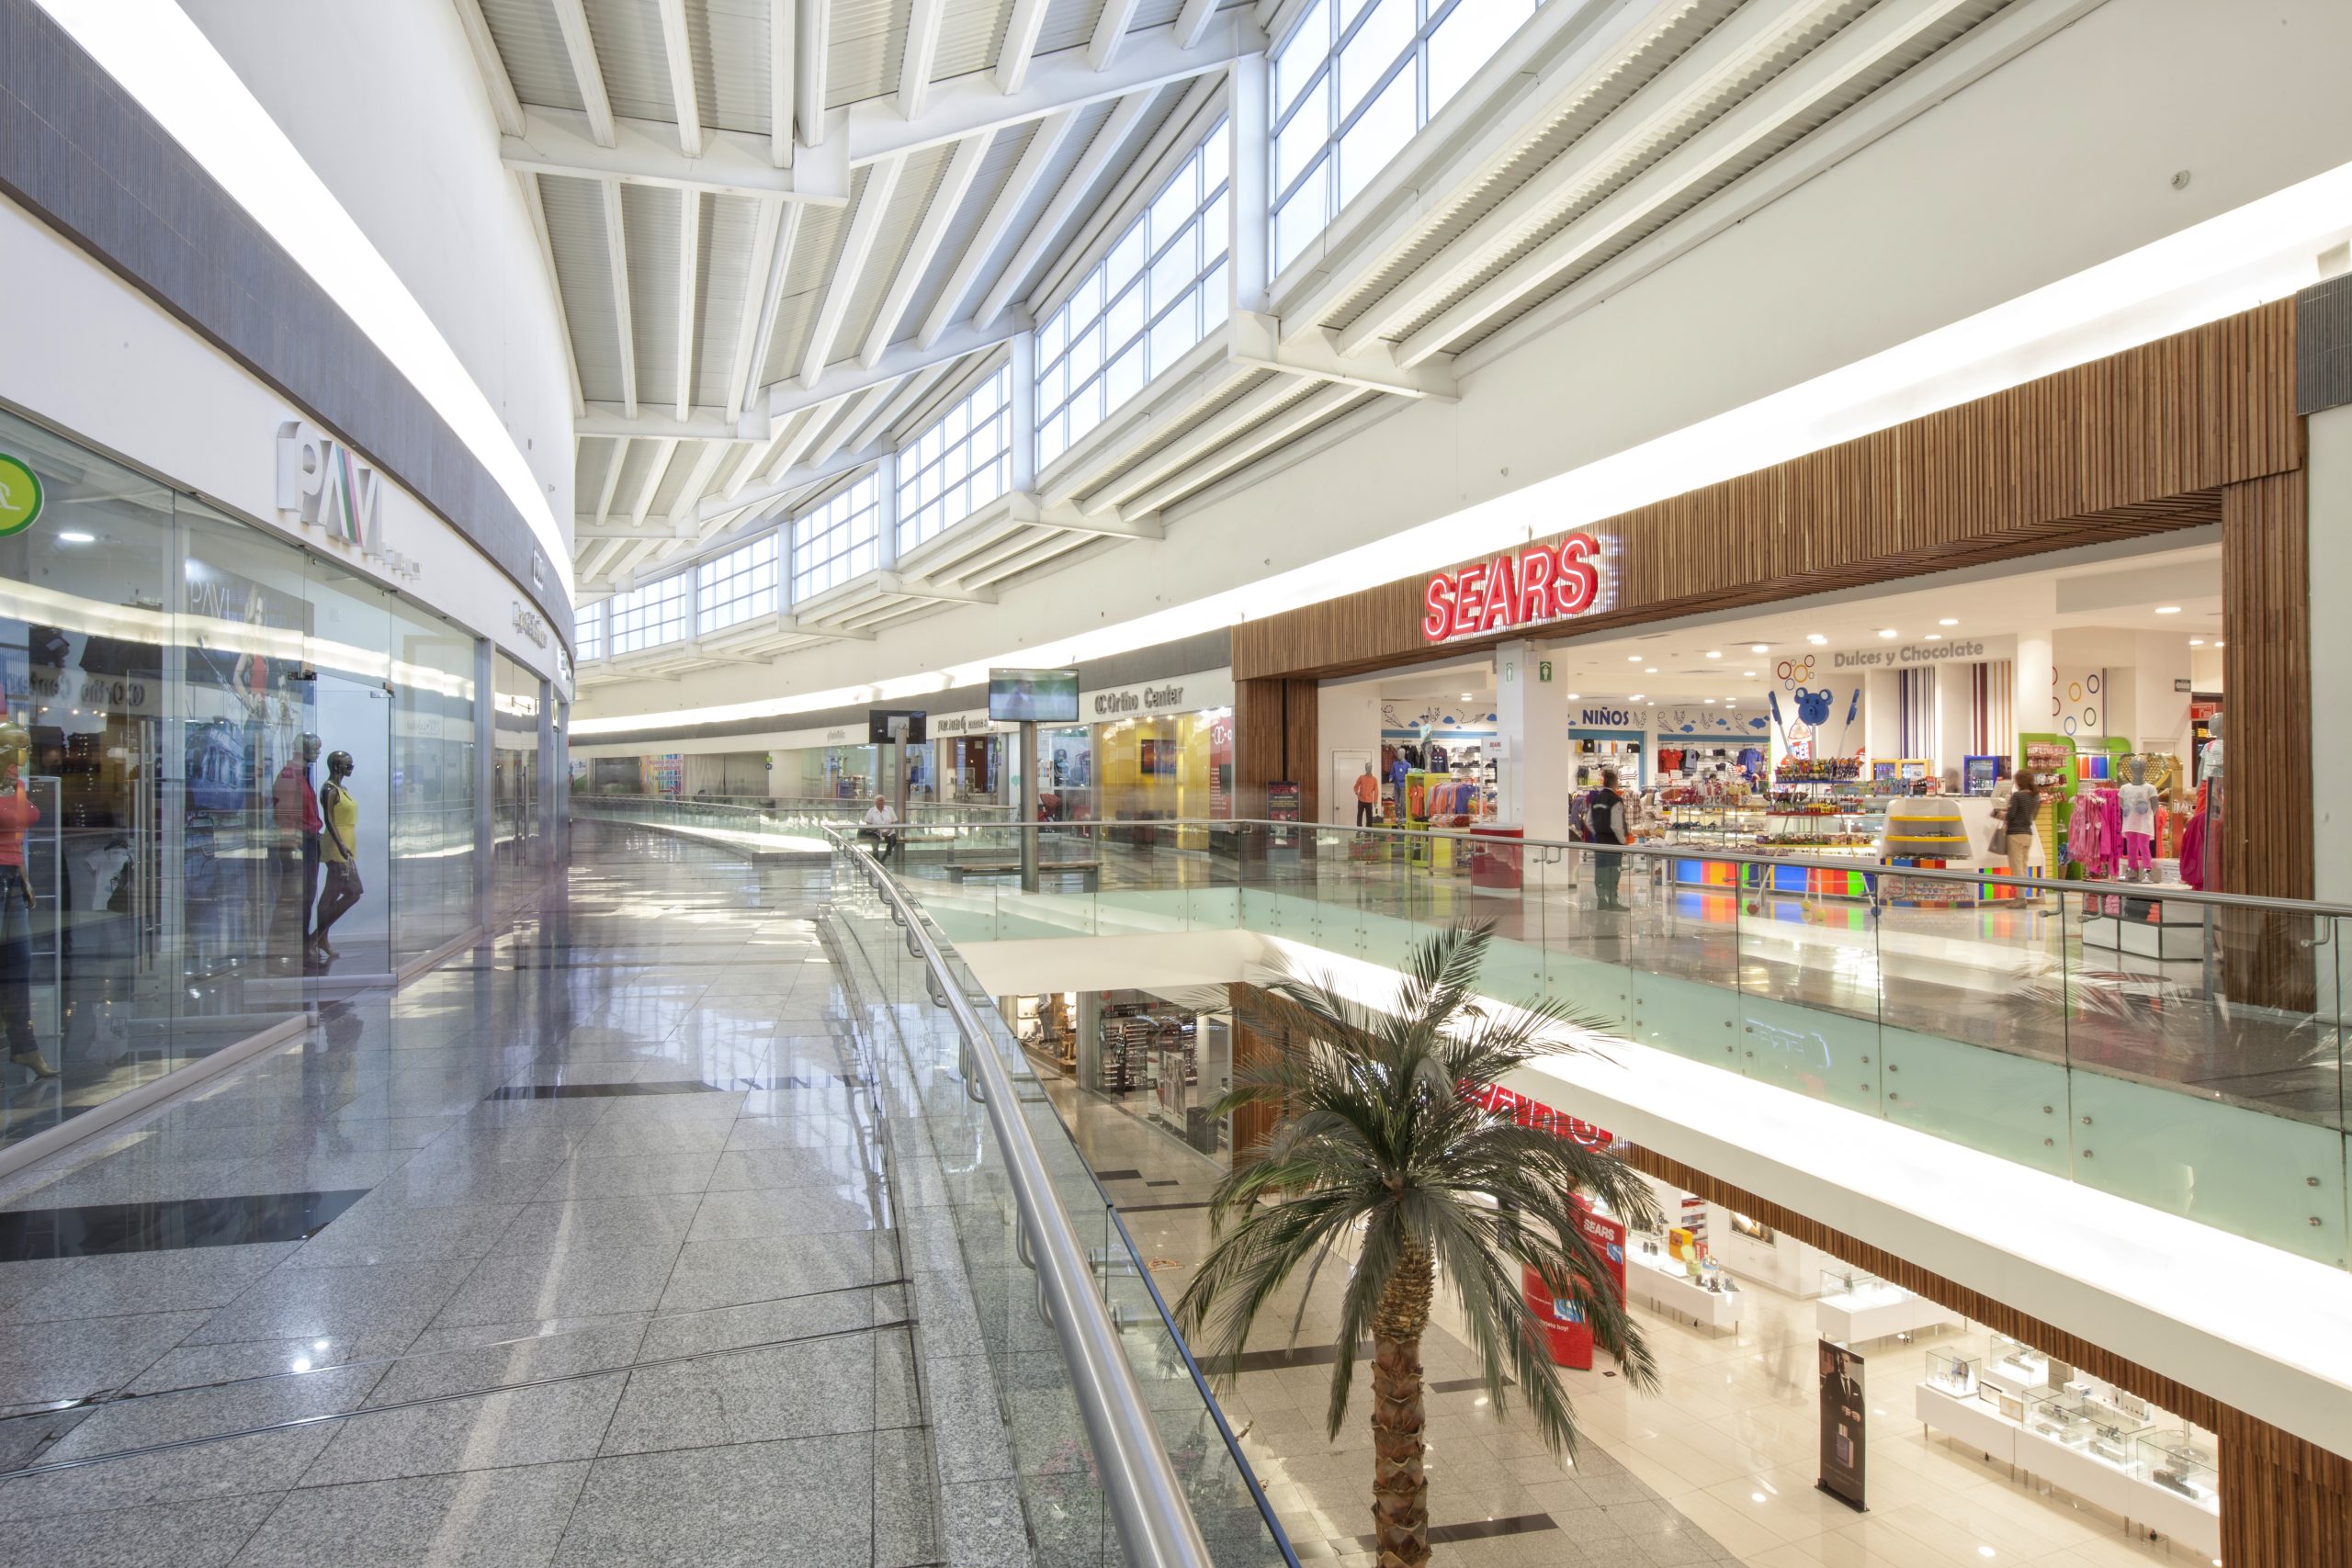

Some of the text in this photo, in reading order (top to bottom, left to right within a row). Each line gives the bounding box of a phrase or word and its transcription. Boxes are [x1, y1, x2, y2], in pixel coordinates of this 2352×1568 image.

[1421, 533, 1600, 642] SEARS
[1834, 641, 1984, 668] Dulces y Chocolate
[1107, 691, 1138, 713] Ortho
[1144, 684, 1183, 708] Center
[1582, 706, 1629, 726] NIÑOS
[1583, 1219, 1615, 1242] SEARS
